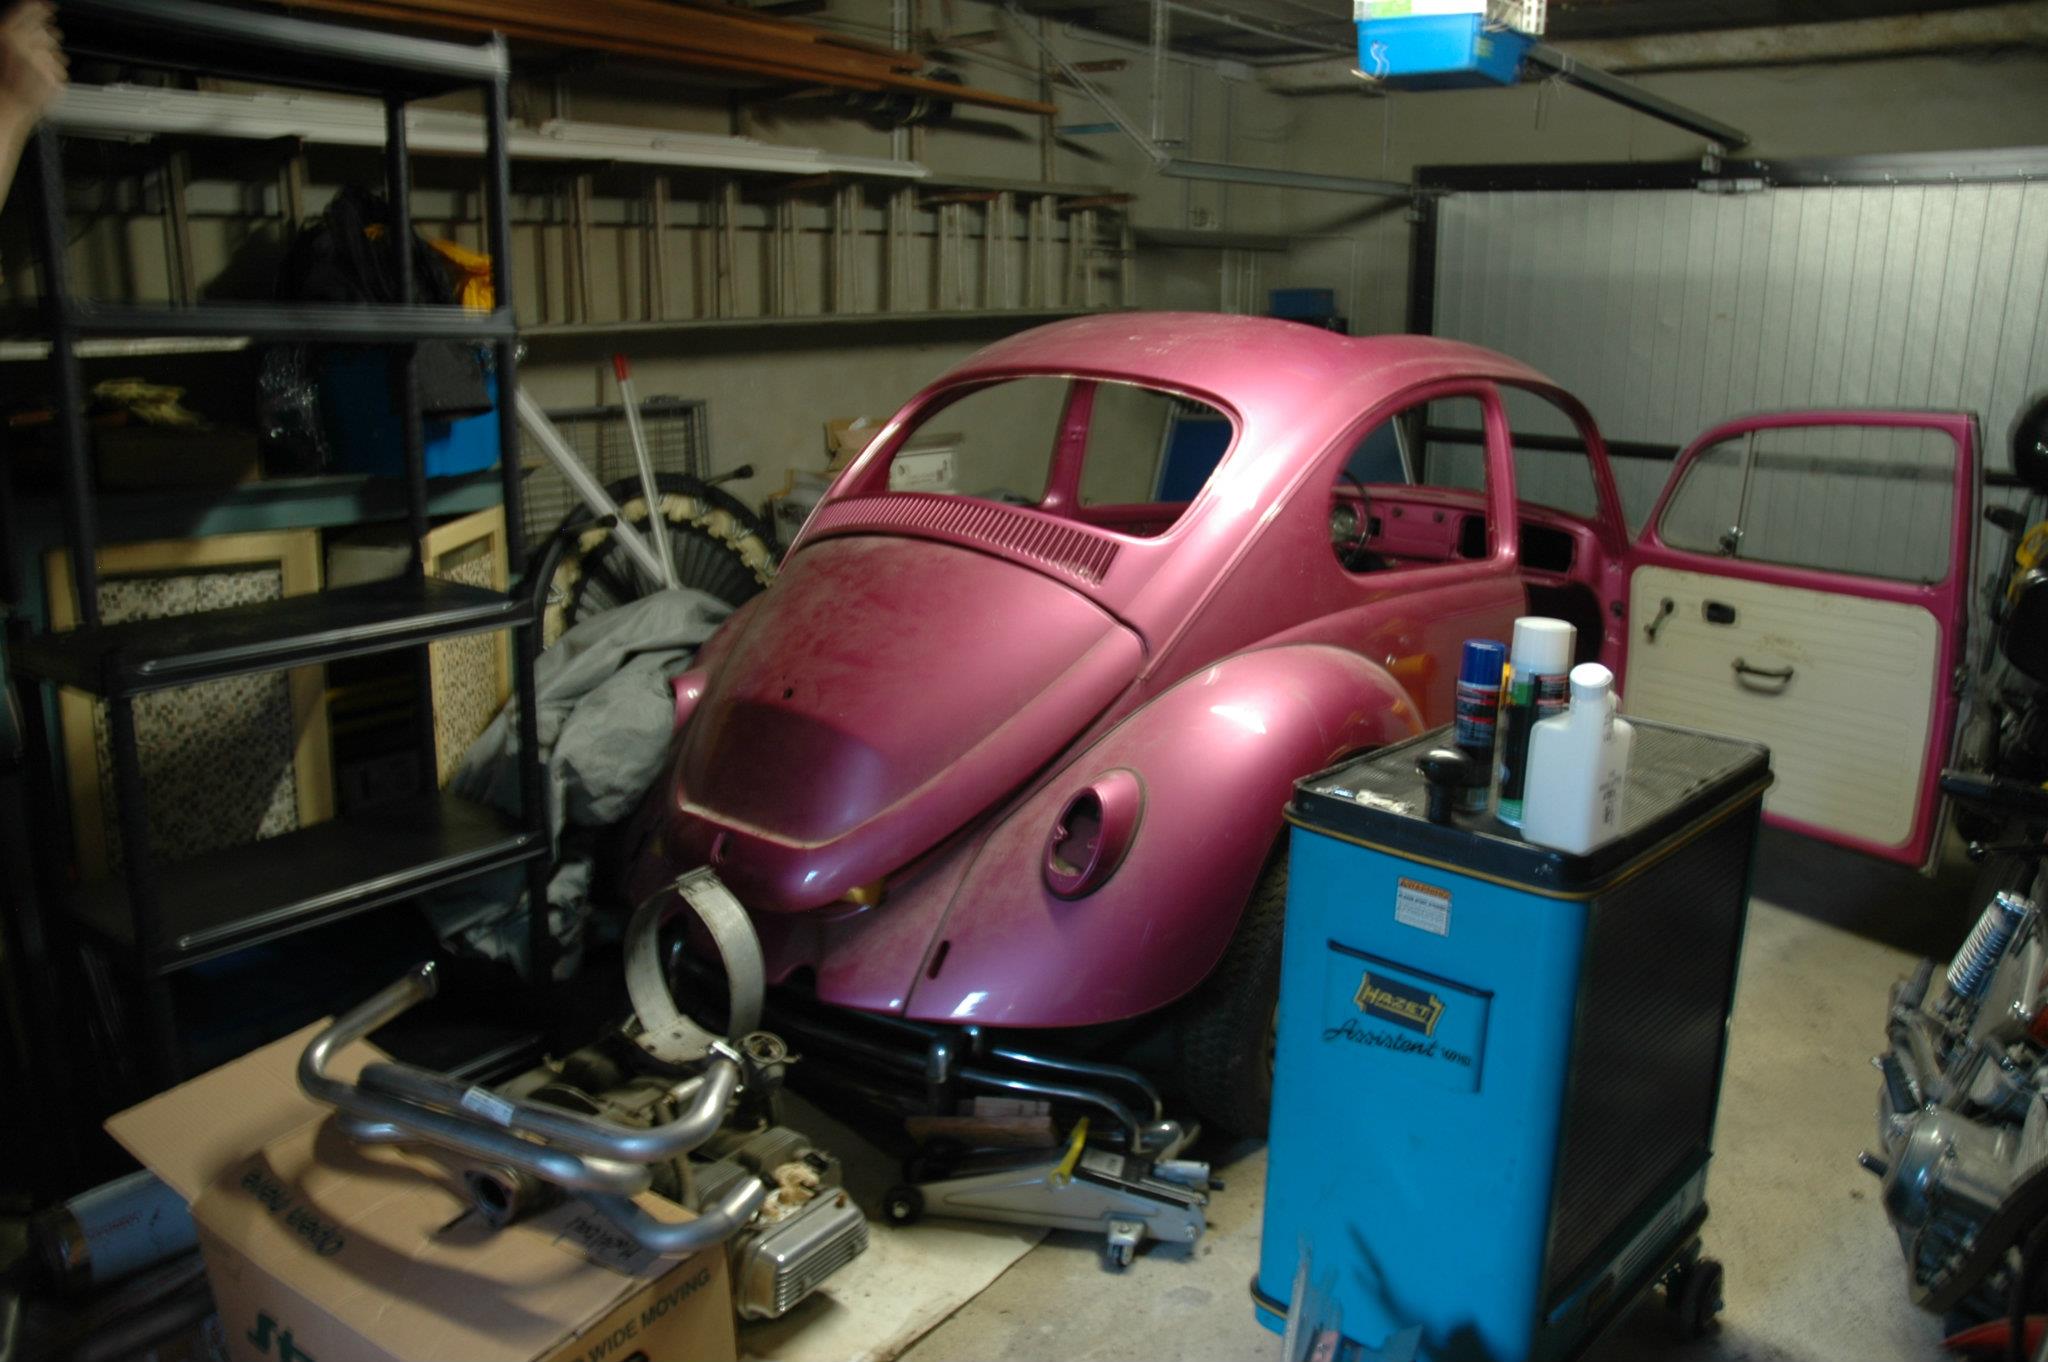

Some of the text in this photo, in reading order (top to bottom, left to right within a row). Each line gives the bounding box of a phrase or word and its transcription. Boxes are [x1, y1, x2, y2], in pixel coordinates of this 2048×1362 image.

[1361, 985, 1432, 1017] HAZET
[1324, 1018, 1436, 1057] Assistant
[588, 1268, 710, 1362] WIDE MOVING
